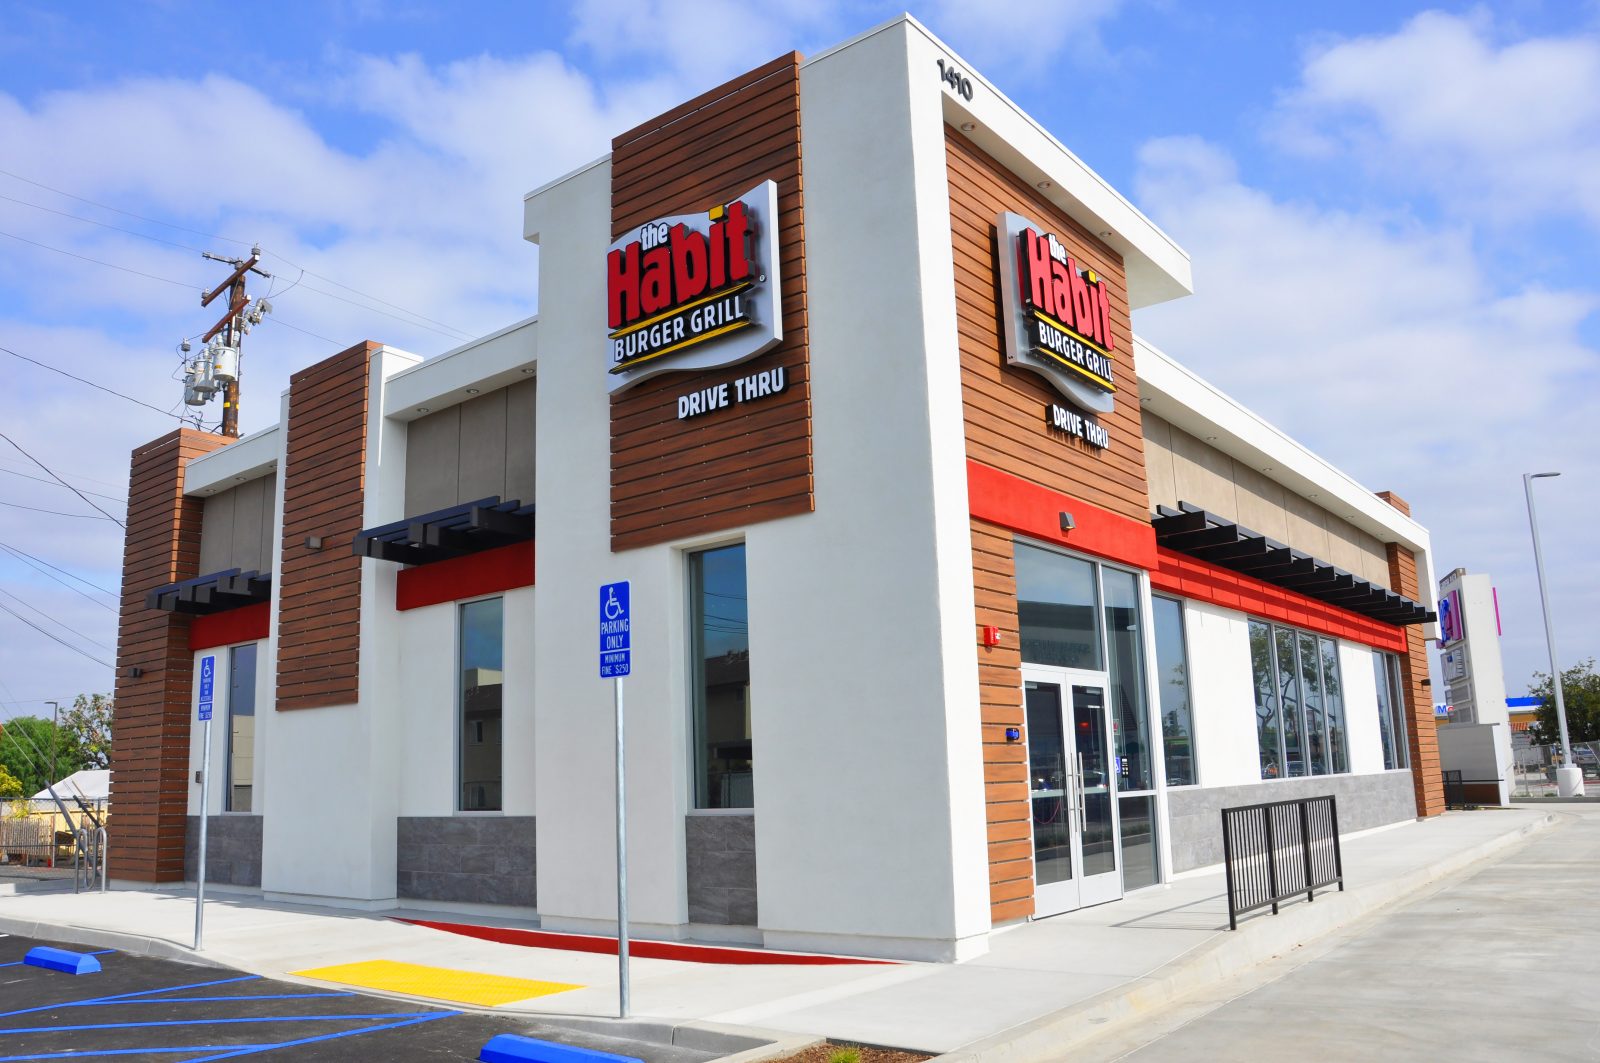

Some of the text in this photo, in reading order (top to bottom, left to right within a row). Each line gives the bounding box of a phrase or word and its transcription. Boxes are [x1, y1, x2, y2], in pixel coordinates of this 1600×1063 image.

[937, 59, 973, 102] 1410
[641, 223, 668, 250] the
[1049, 233, 1067, 263] the
[607, 200, 750, 328] Habit
[1026, 227, 1114, 351] Habit
[615, 296, 743, 361] BURGER GRILL
[1038, 322, 1114, 382] BURGER GRILL
[678, 367, 784, 419] DRIVE THRU
[1052, 404, 1109, 449] DRIVE THRU
[601, 618, 628, 634] PARKING
[607, 634, 623, 649] ONLY
[602, 665, 612, 675] FINE
[605, 653, 625, 663] MINIMUM
